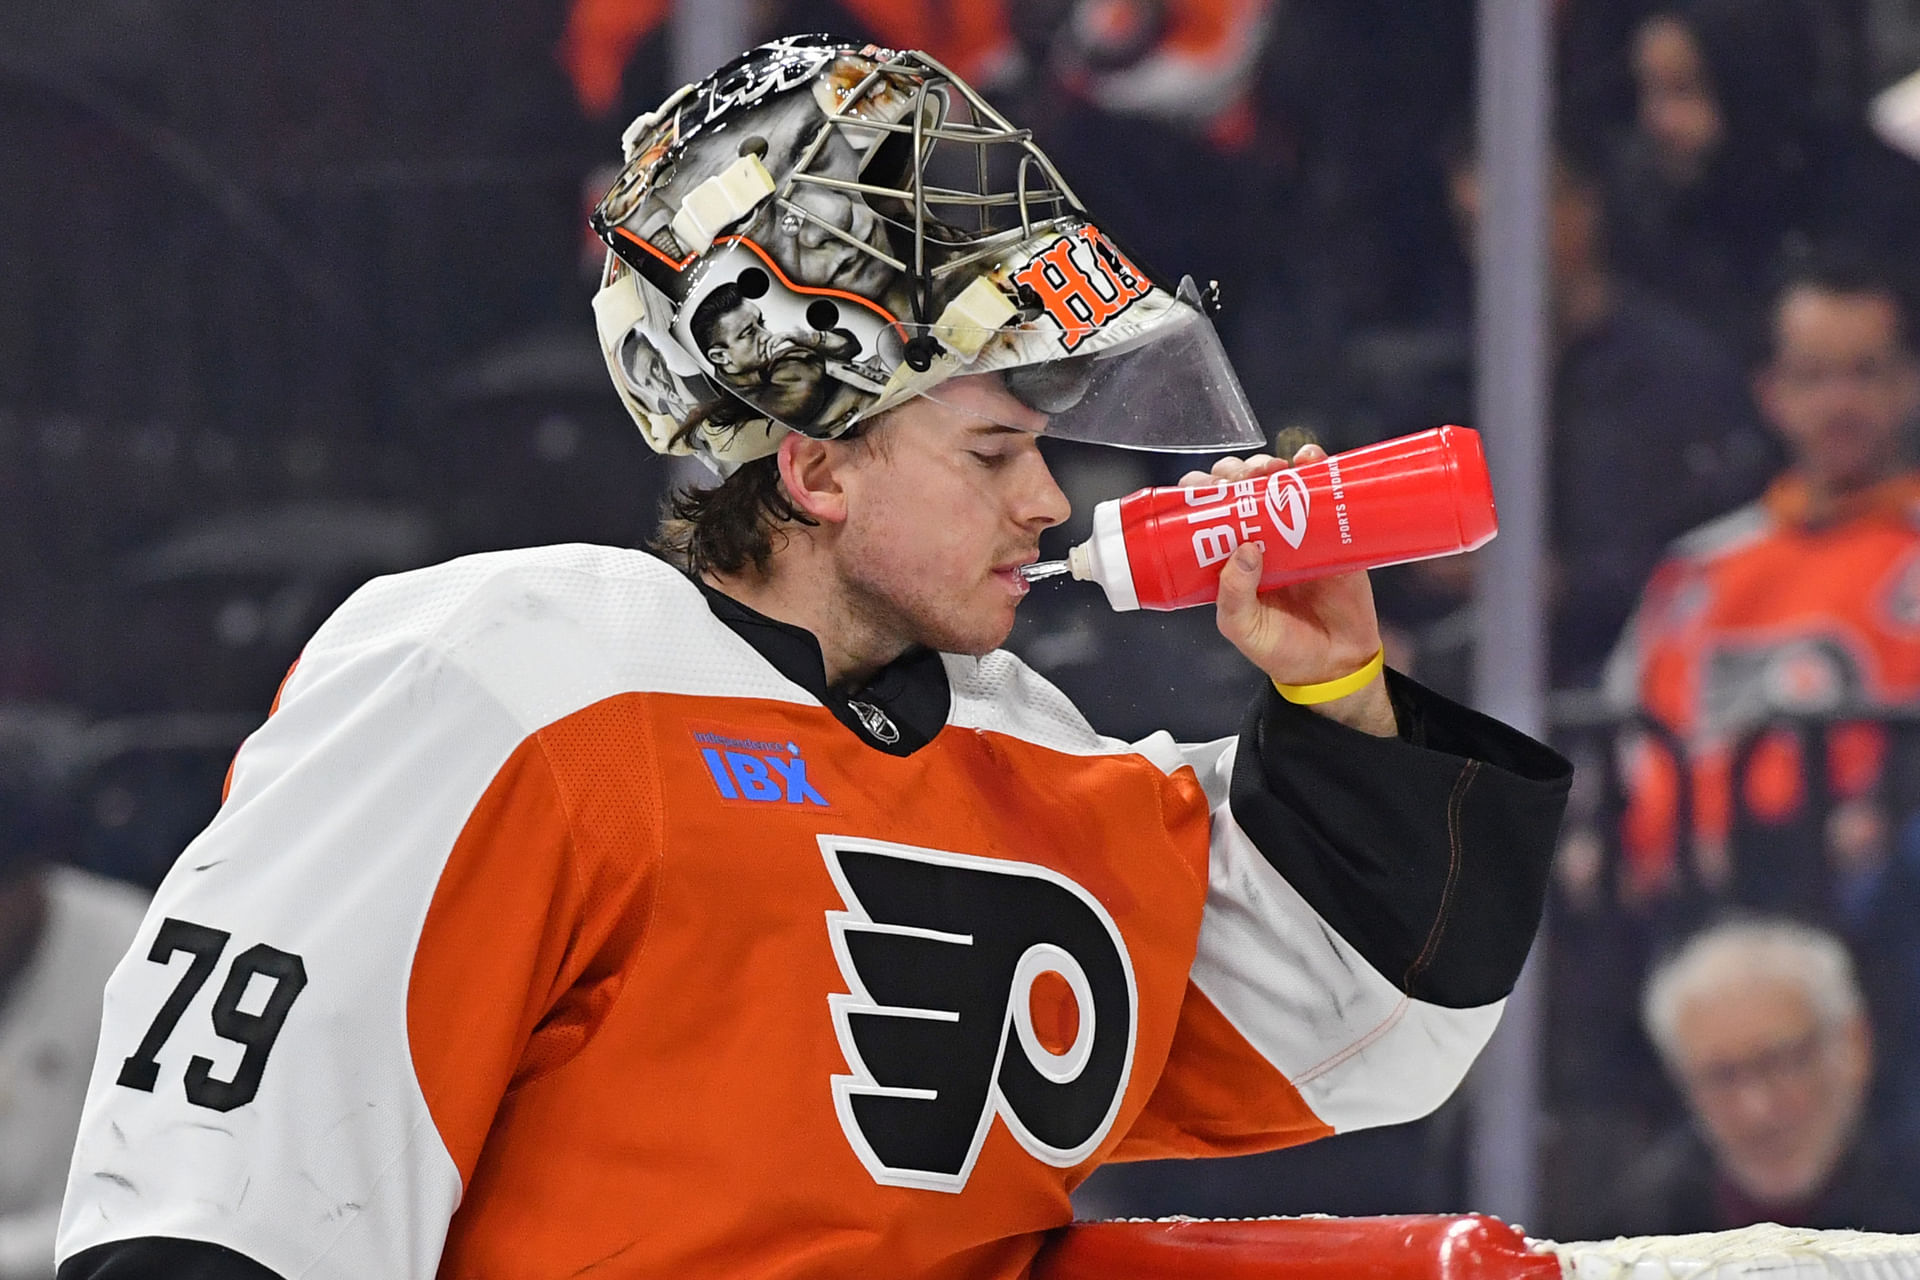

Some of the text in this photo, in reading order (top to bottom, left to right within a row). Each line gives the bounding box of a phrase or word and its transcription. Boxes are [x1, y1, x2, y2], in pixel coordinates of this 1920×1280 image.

[1336, 503, 1352, 545] SPORTS
[701, 748, 830, 807] IBX
[116, 917, 308, 1113] 79
